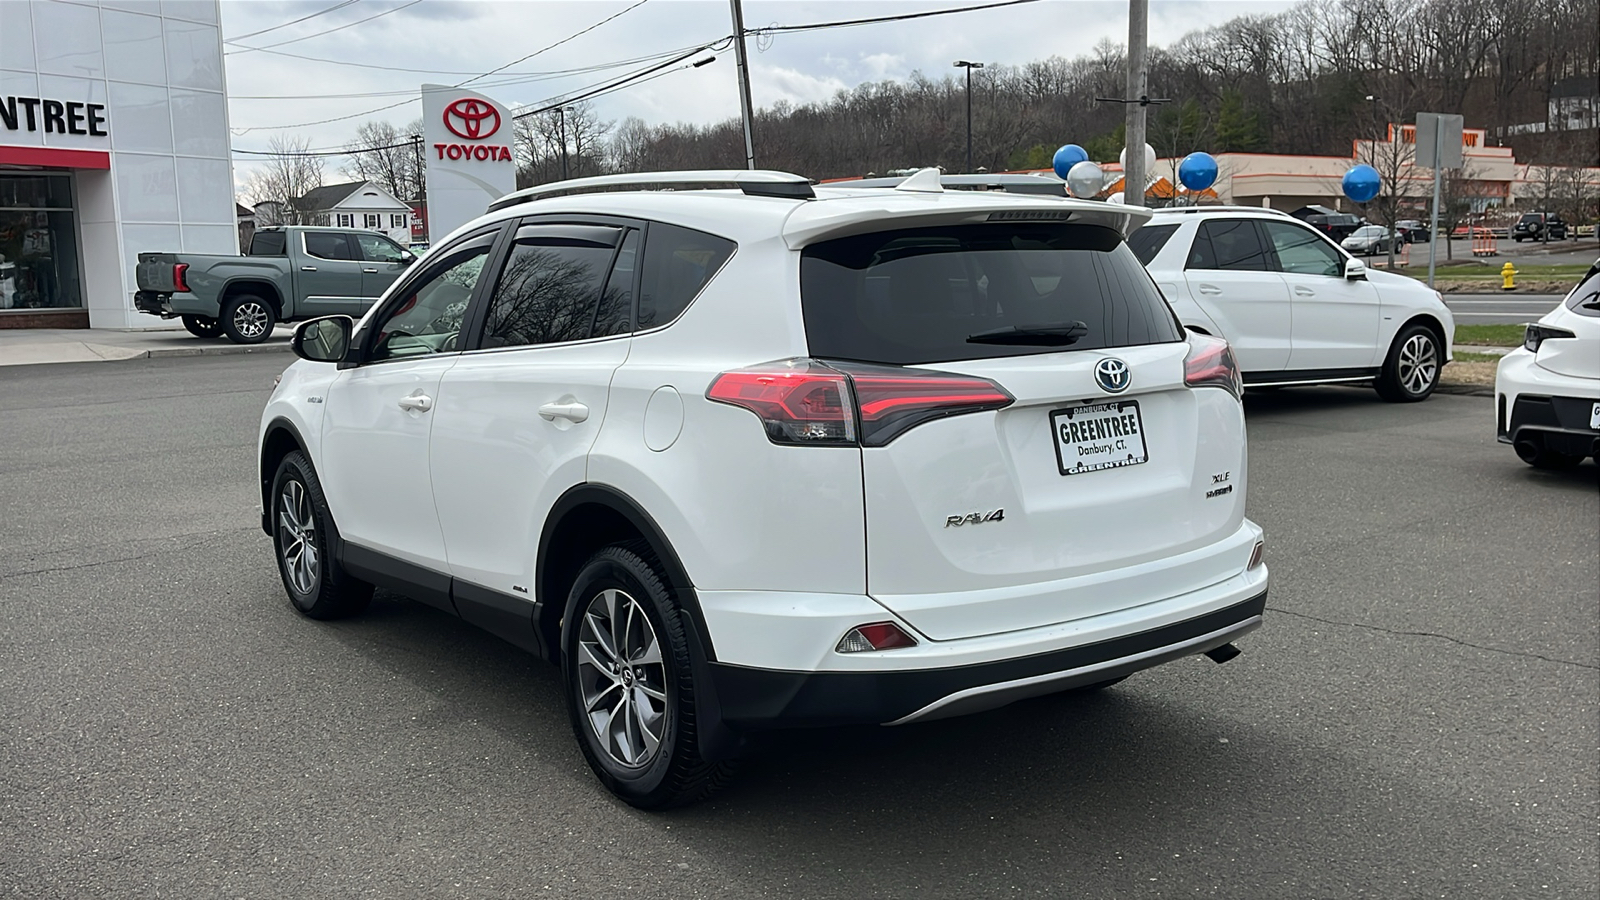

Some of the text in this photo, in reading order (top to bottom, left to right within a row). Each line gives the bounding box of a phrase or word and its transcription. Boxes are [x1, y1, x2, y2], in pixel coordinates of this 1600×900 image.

[434, 144, 512, 161] TOYOTA
[1059, 414, 1138, 445] GREENTREE
[1077, 442, 1115, 457] Danbury,
[1068, 457, 1145, 475] GREENTREE
[1211, 471, 1230, 485] XLE
[944, 508, 1005, 528] RAV4
